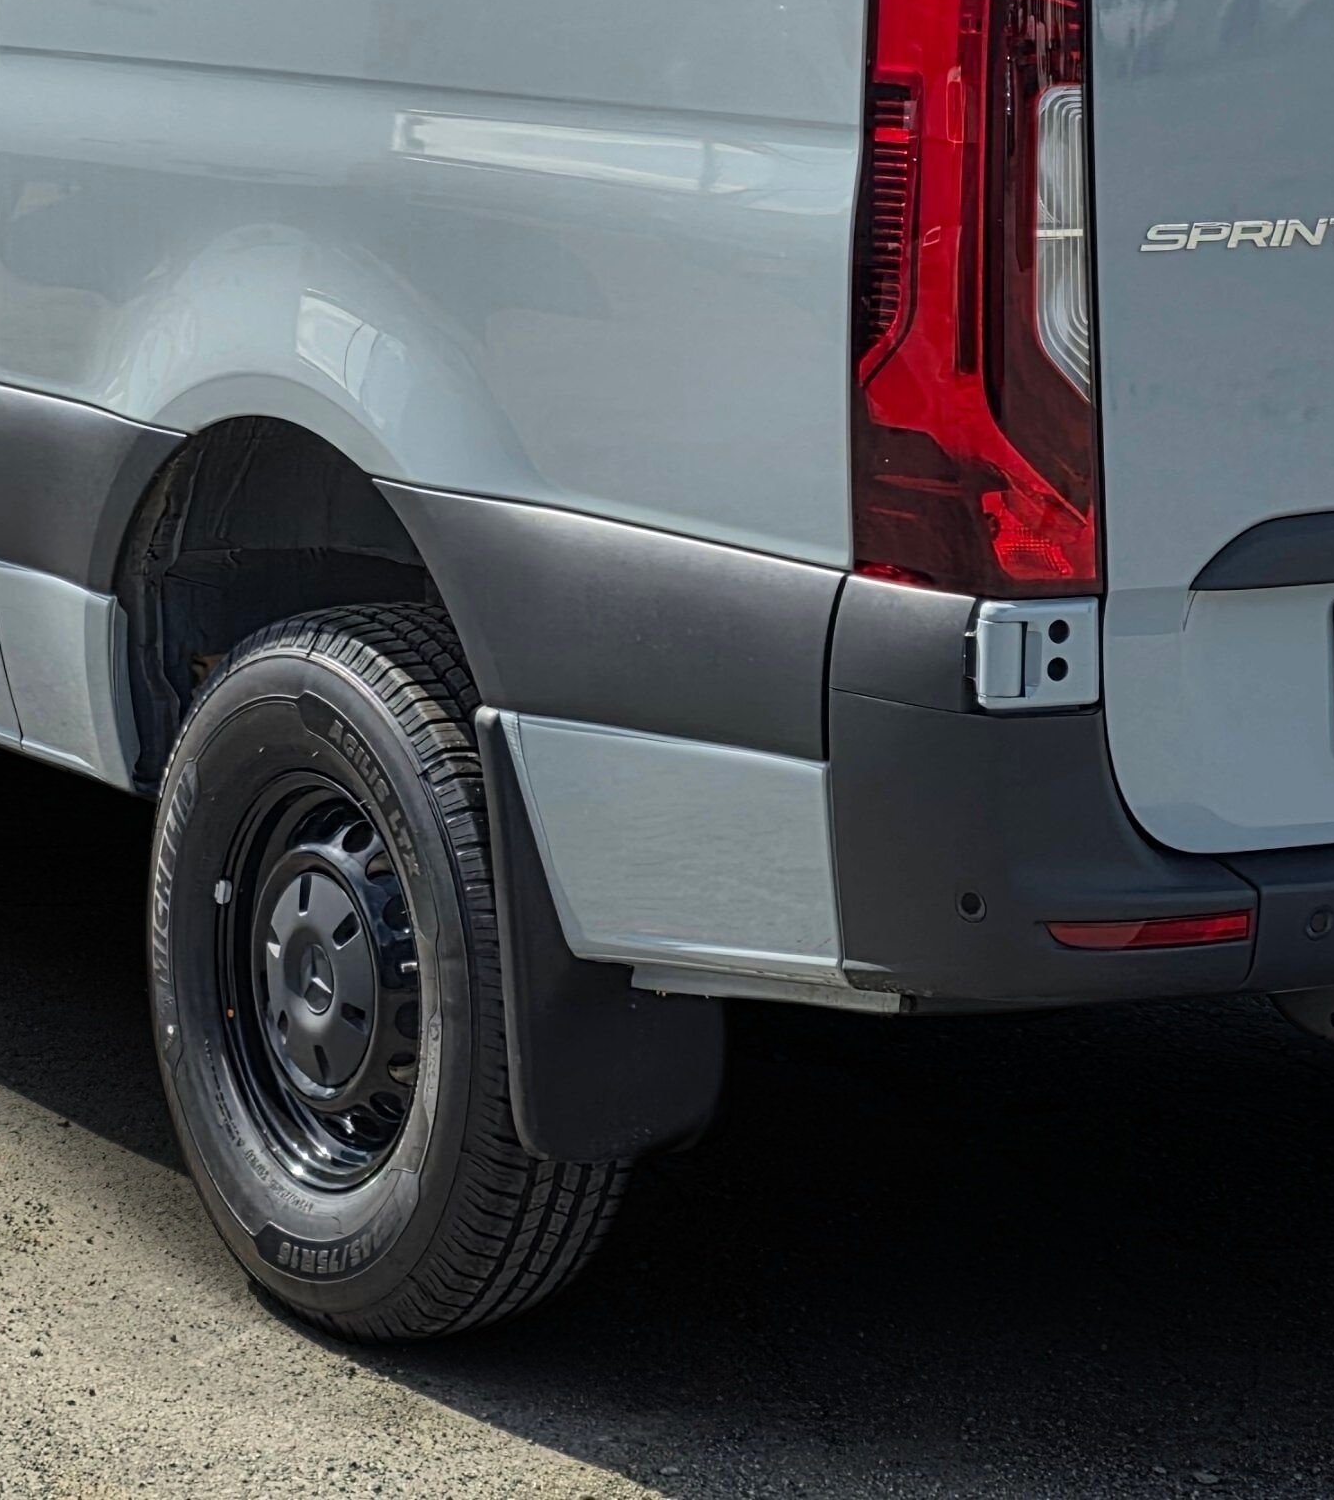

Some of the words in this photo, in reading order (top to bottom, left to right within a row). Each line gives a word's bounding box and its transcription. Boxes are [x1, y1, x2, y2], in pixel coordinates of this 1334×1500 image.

[152, 764, 194, 987] MICHELIN
[327, 719, 391, 803] AGILIS
[387, 809, 421, 877] LTX
